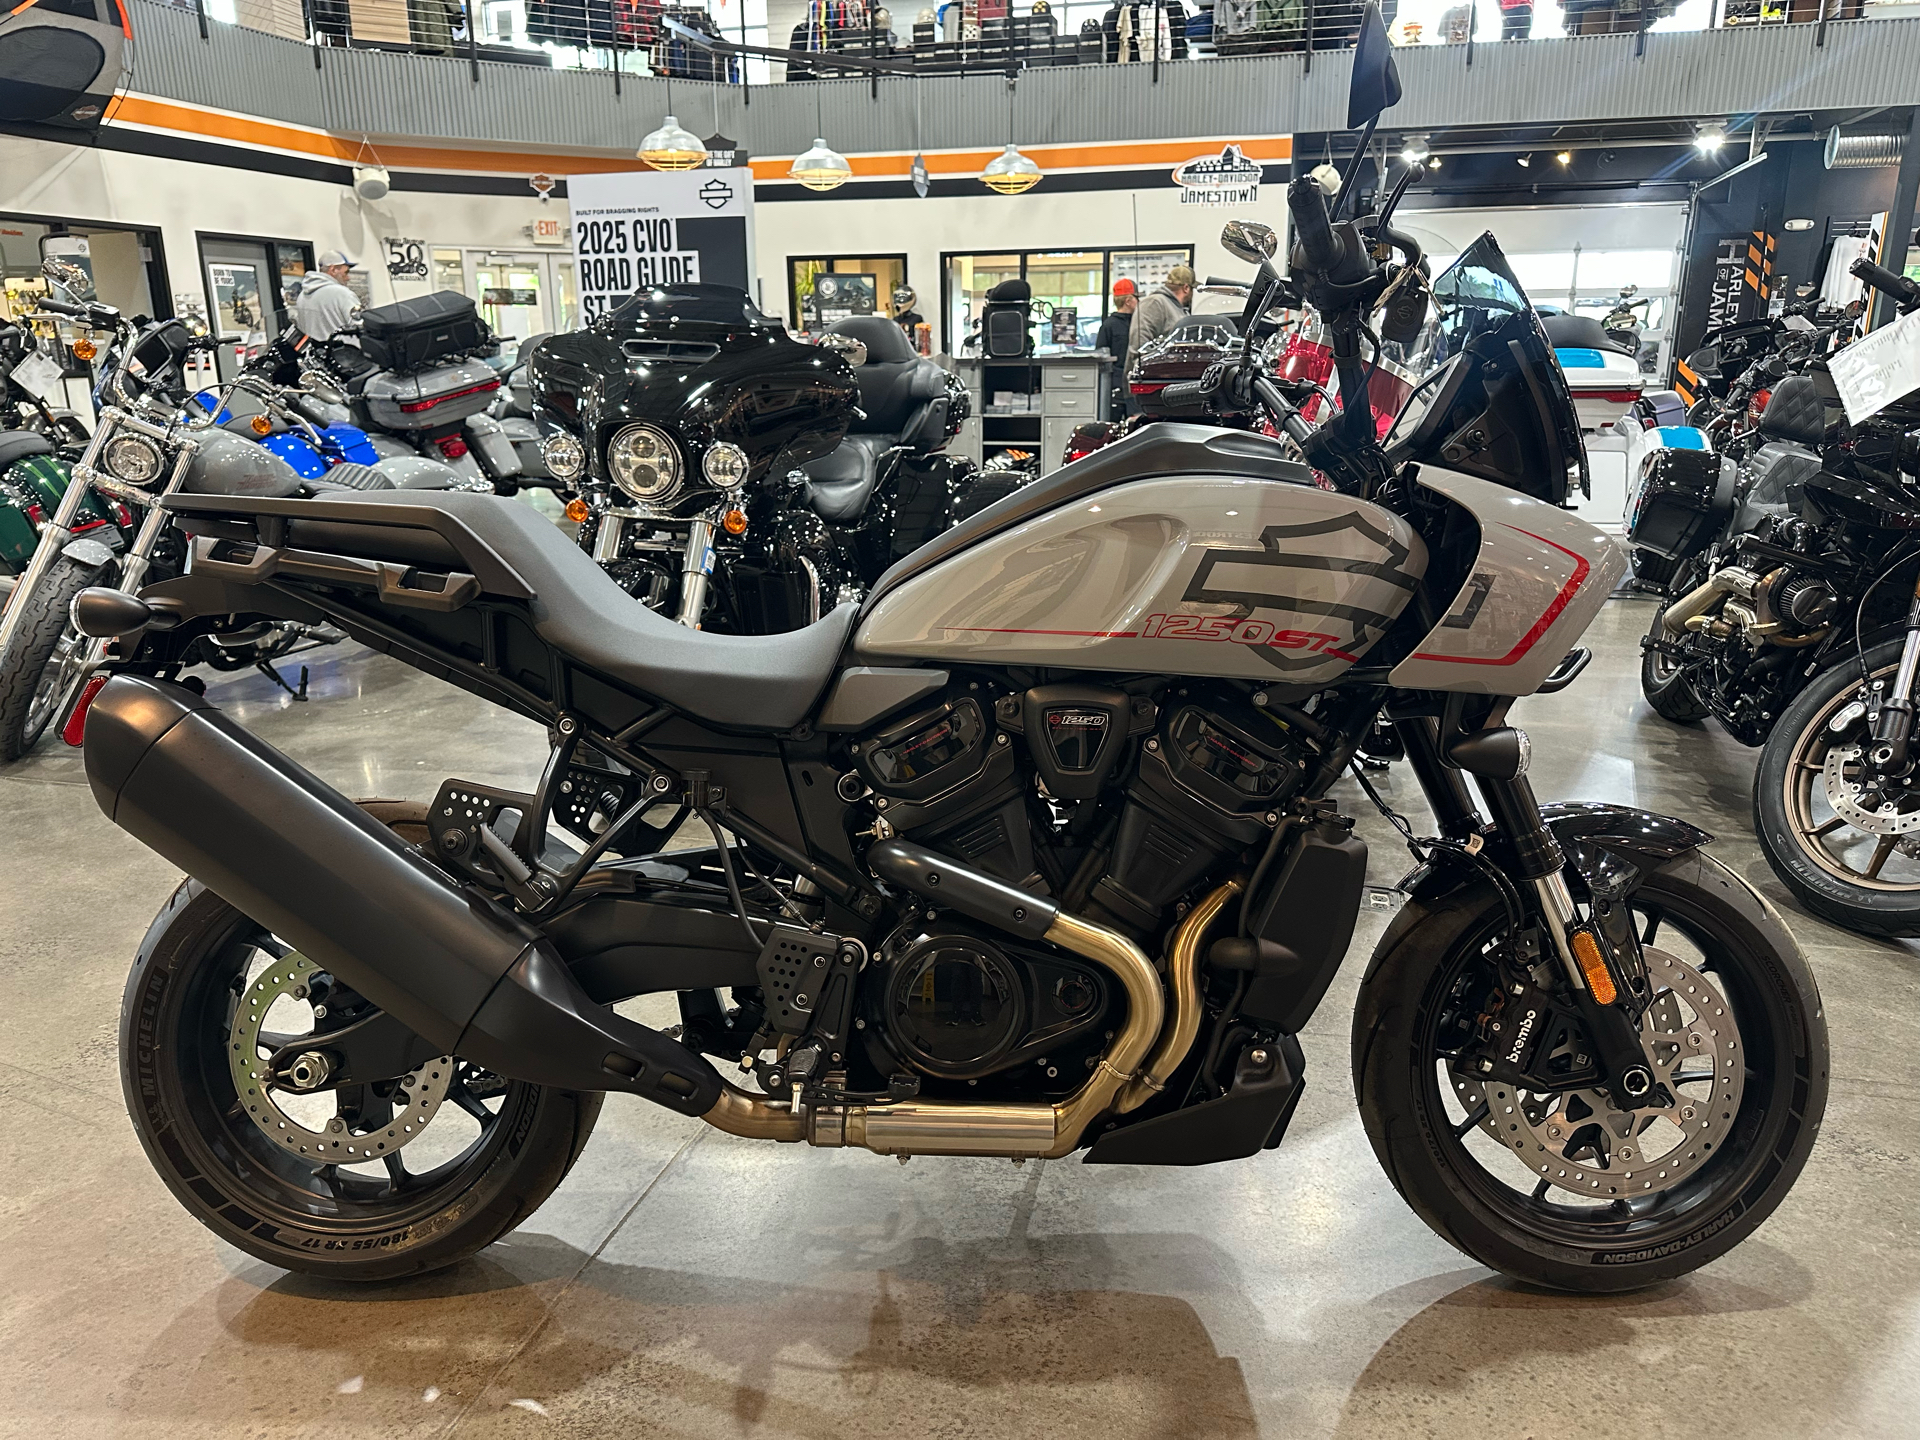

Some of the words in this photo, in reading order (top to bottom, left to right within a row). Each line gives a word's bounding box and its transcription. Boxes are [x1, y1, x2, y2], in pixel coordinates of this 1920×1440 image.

[1181, 173, 1259, 185] HARLEY-DAVIDSON
[1181, 185, 1258, 204] JAMESTOWN
[538, 220, 557, 235] EXIT
[577, 220, 627, 254] 2025
[633, 218, 671, 253] CVO
[580, 257, 631, 292] ROAD
[1716, 239, 1748, 326] HARLEY
[1061, 715, 1106, 726] 1250
[1790, 858, 1853, 899] MICHELIN
[1763, 955, 1791, 1003] SCORCHER
[138, 973, 164, 1097] MICHELIN
[1505, 1010, 1537, 1064] brembo
[301, 1237, 320, 1248] 17
[351, 1230, 409, 1251] 180/55
[1602, 1210, 1735, 1264] HARLEY-DAVIDSON
